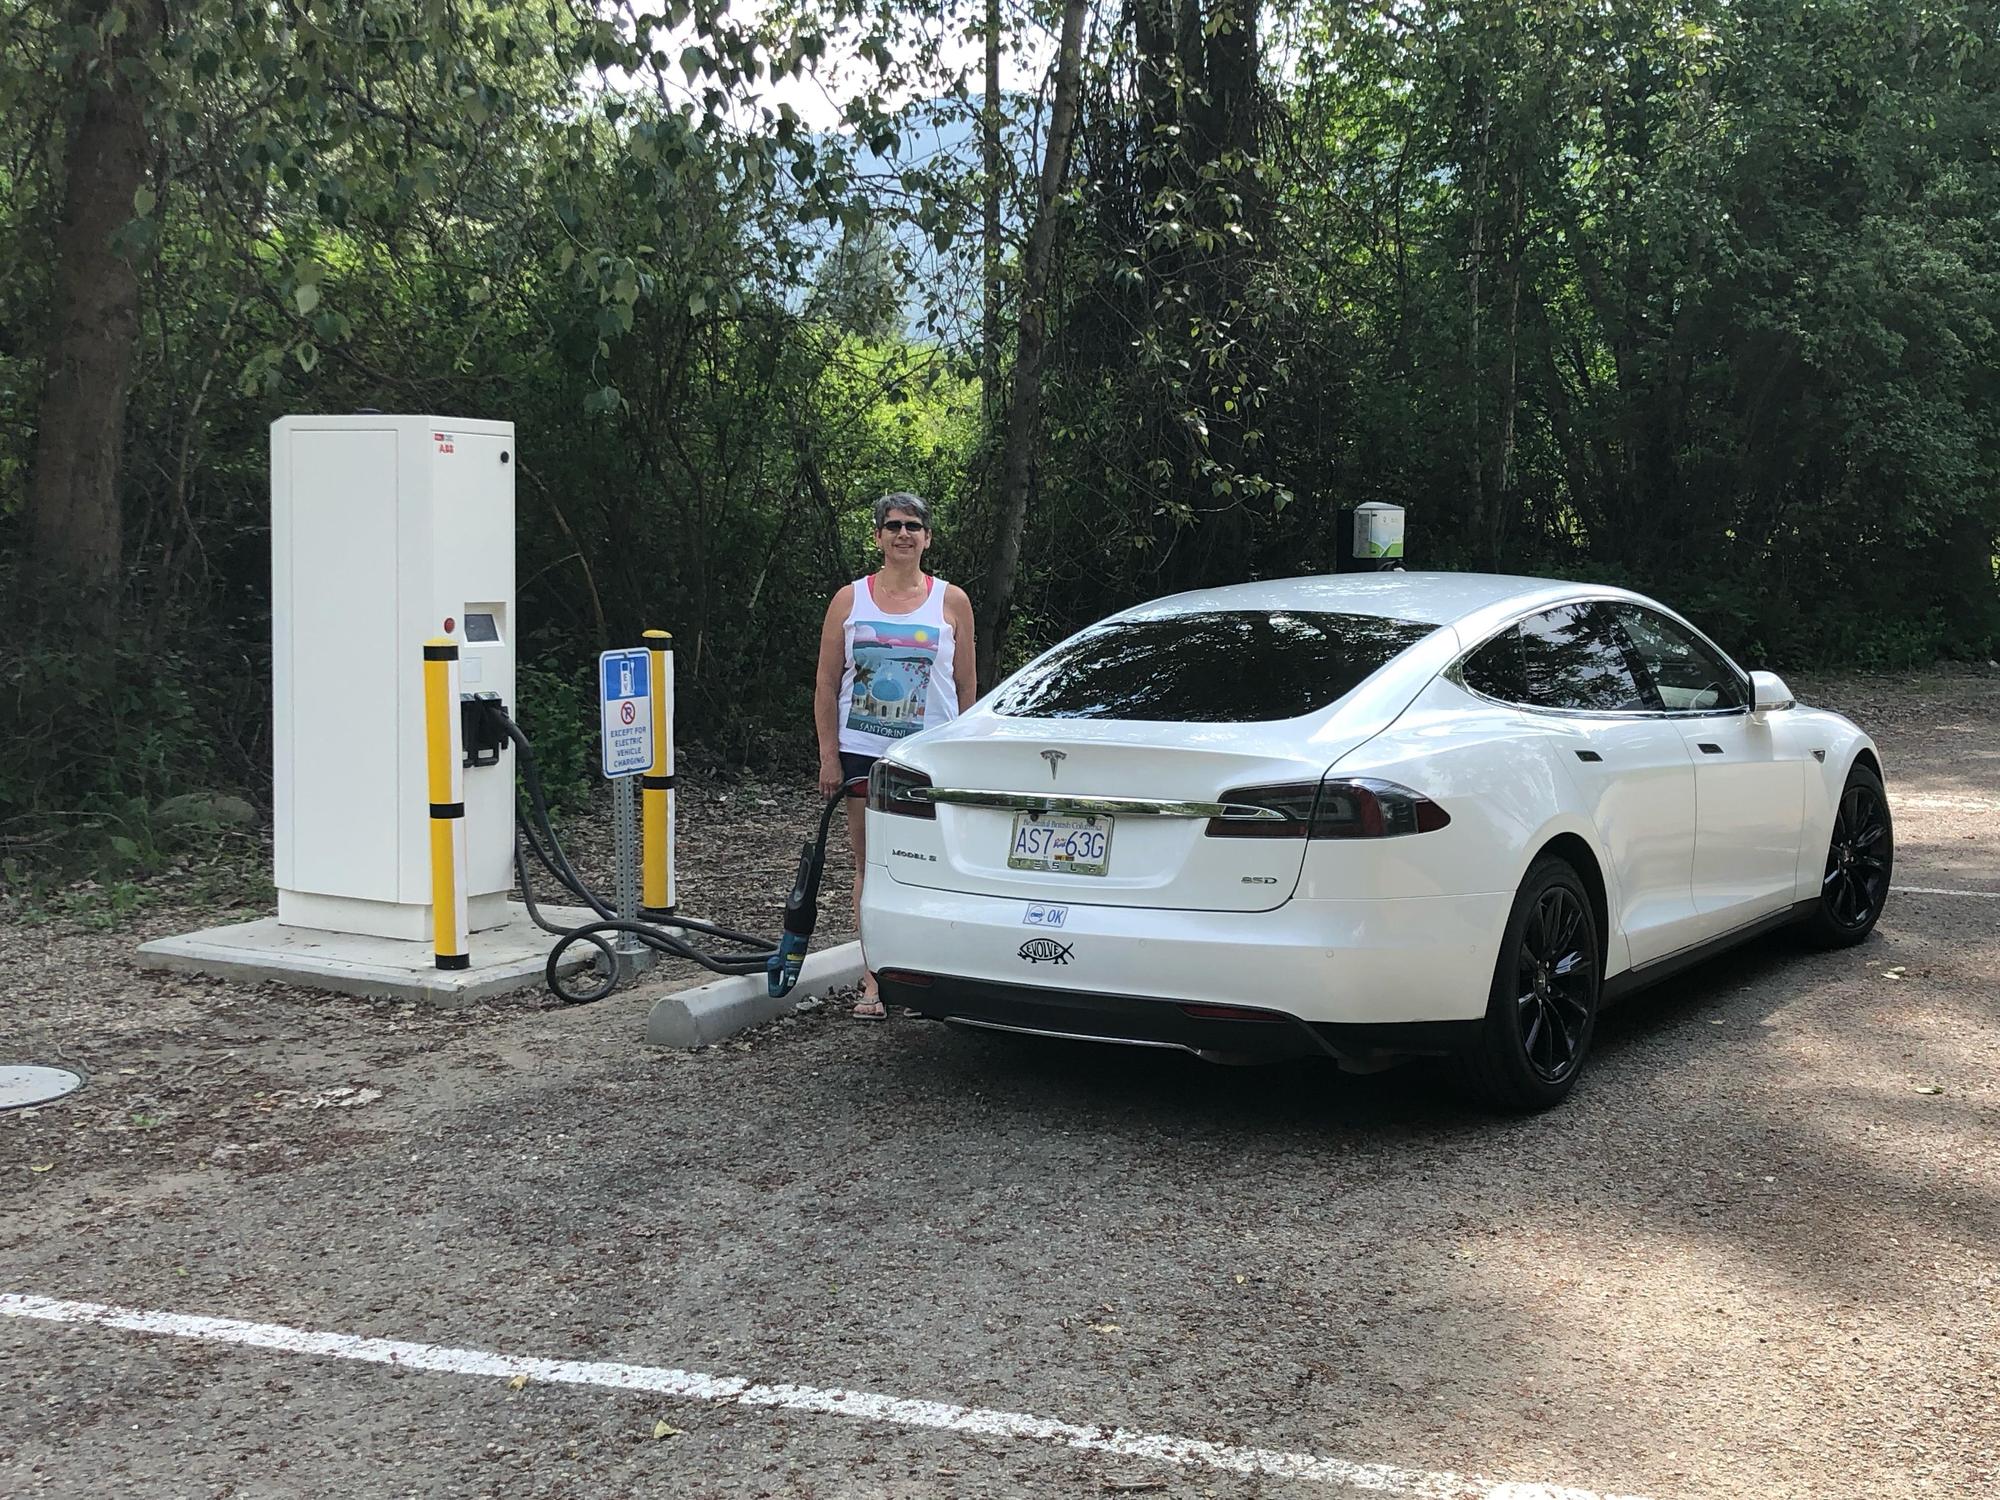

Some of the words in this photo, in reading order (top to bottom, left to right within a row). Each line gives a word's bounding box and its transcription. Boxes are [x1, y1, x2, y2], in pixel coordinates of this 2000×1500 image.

[439, 444, 454, 453] ABB
[611, 727, 633, 738] EXCEPT
[635, 726, 647, 734] FOR
[859, 722, 906, 737] SANTORINI
[615, 736, 642, 748] ELECTRIC
[617, 747, 641, 757] VEHICLE
[614, 756, 645, 768] CHARGING
[1015, 827, 1055, 855] AS7
[1065, 830, 1105, 859] 63G
[892, 849, 927, 861] MODEL
[1047, 909, 1065, 924] OK
[1026, 941, 1061, 958] EVOLVE
